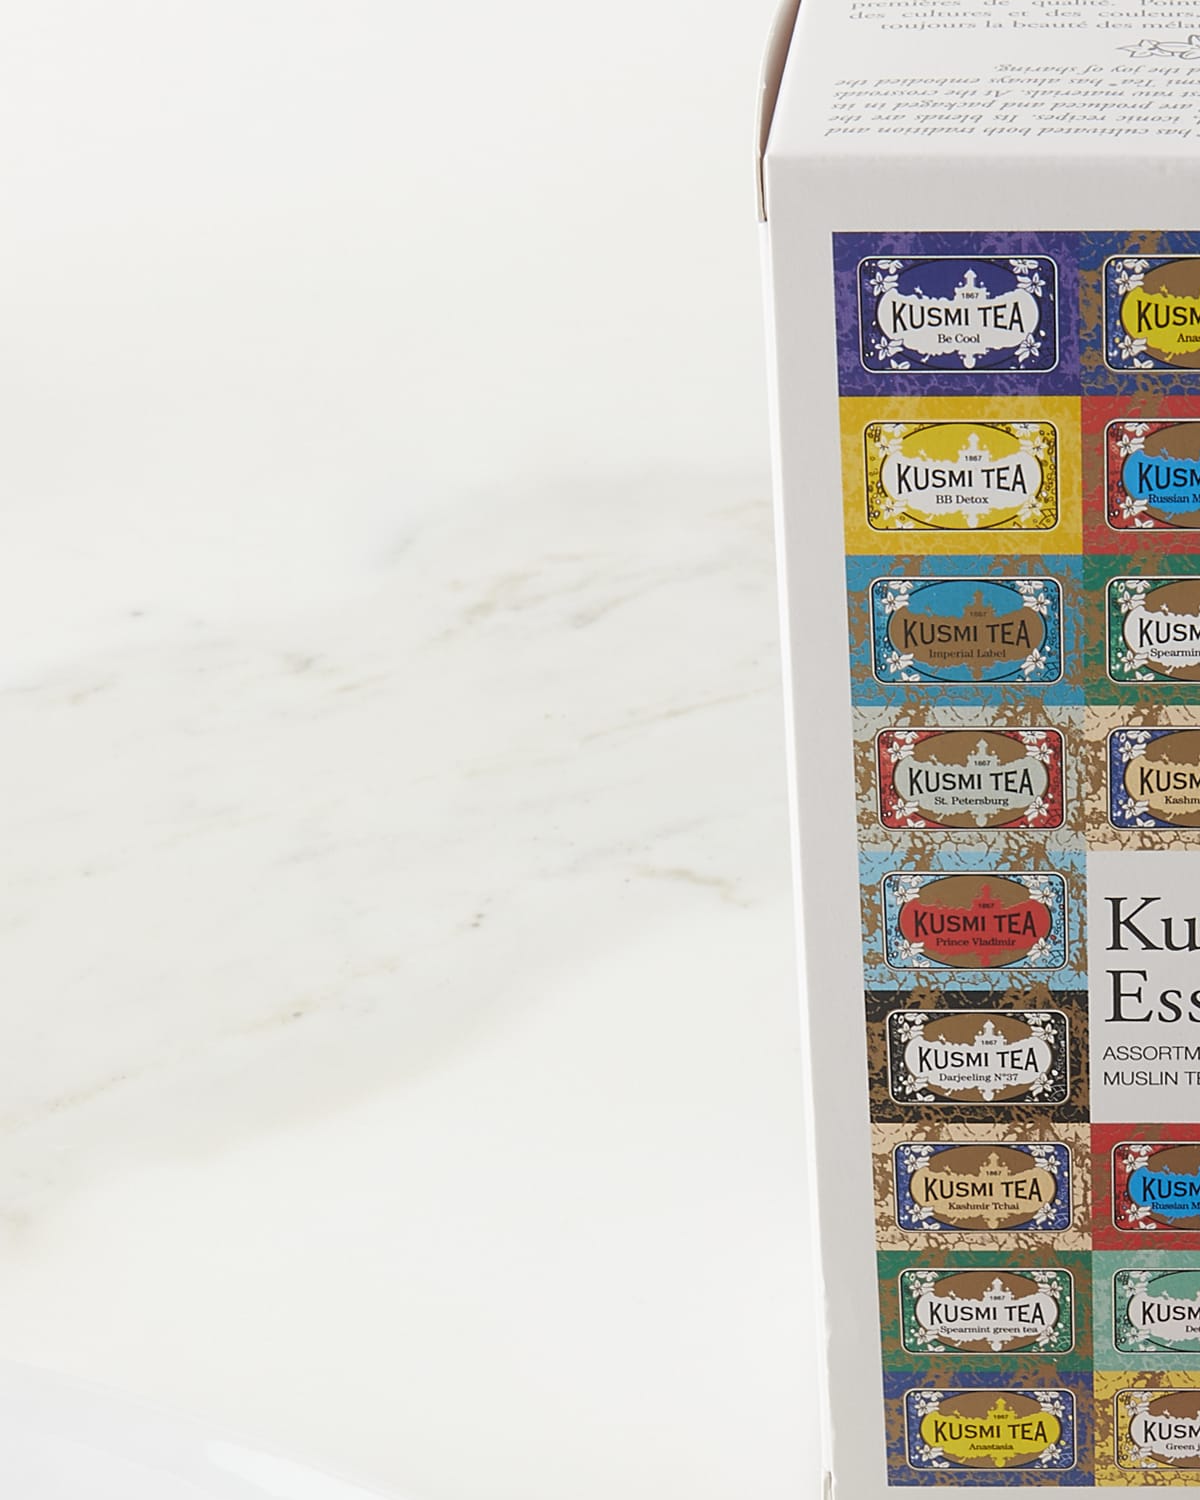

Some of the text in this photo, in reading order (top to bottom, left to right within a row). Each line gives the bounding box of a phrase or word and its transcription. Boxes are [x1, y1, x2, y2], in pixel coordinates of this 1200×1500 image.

[881, 22, 976, 30] toujours
[1077, 65, 1103, 75] of
[1111, 66, 1142, 74] joy
[829, 115, 862, 123] the
[914, 115, 983, 123] blends
[993, 115, 1017, 123] Its
[1116, 115, 1180, 124] iconic
[892, 301, 1024, 333] KUSMI TEA
[939, 335, 980, 343] Be Cool
[898, 464, 1026, 494] KUSMI TEA
[936, 495, 988, 504] BB Detox
[1148, 494, 1190, 503] Russian
[904, 619, 1030, 648] KUSMI TEA
[929, 649, 1006, 659] Imperial Label
[909, 768, 1033, 796] KUSMI TEA
[952, 796, 1008, 806] Petersburg
[914, 910, 1036, 938] KUSMI TEA
[936, 938, 1016, 946] Prince Vladimir
[919, 1046, 1038, 1072] KUSMI TEA
[939, 1074, 991, 1082] Darjeeling
[1103, 1071, 1179, 1086] MUSLIN
[925, 1177, 1042, 1202] KUSMI TEA
[948, 1202, 1019, 1210] Kashmir Tchai
[930, 1302, 1045, 1325] KUSMI TEA
[940, 1326, 990, 1334] Spearmint
[993, 1326, 1020, 1334] green
[935, 1420, 1048, 1443] KUSMI TEA
